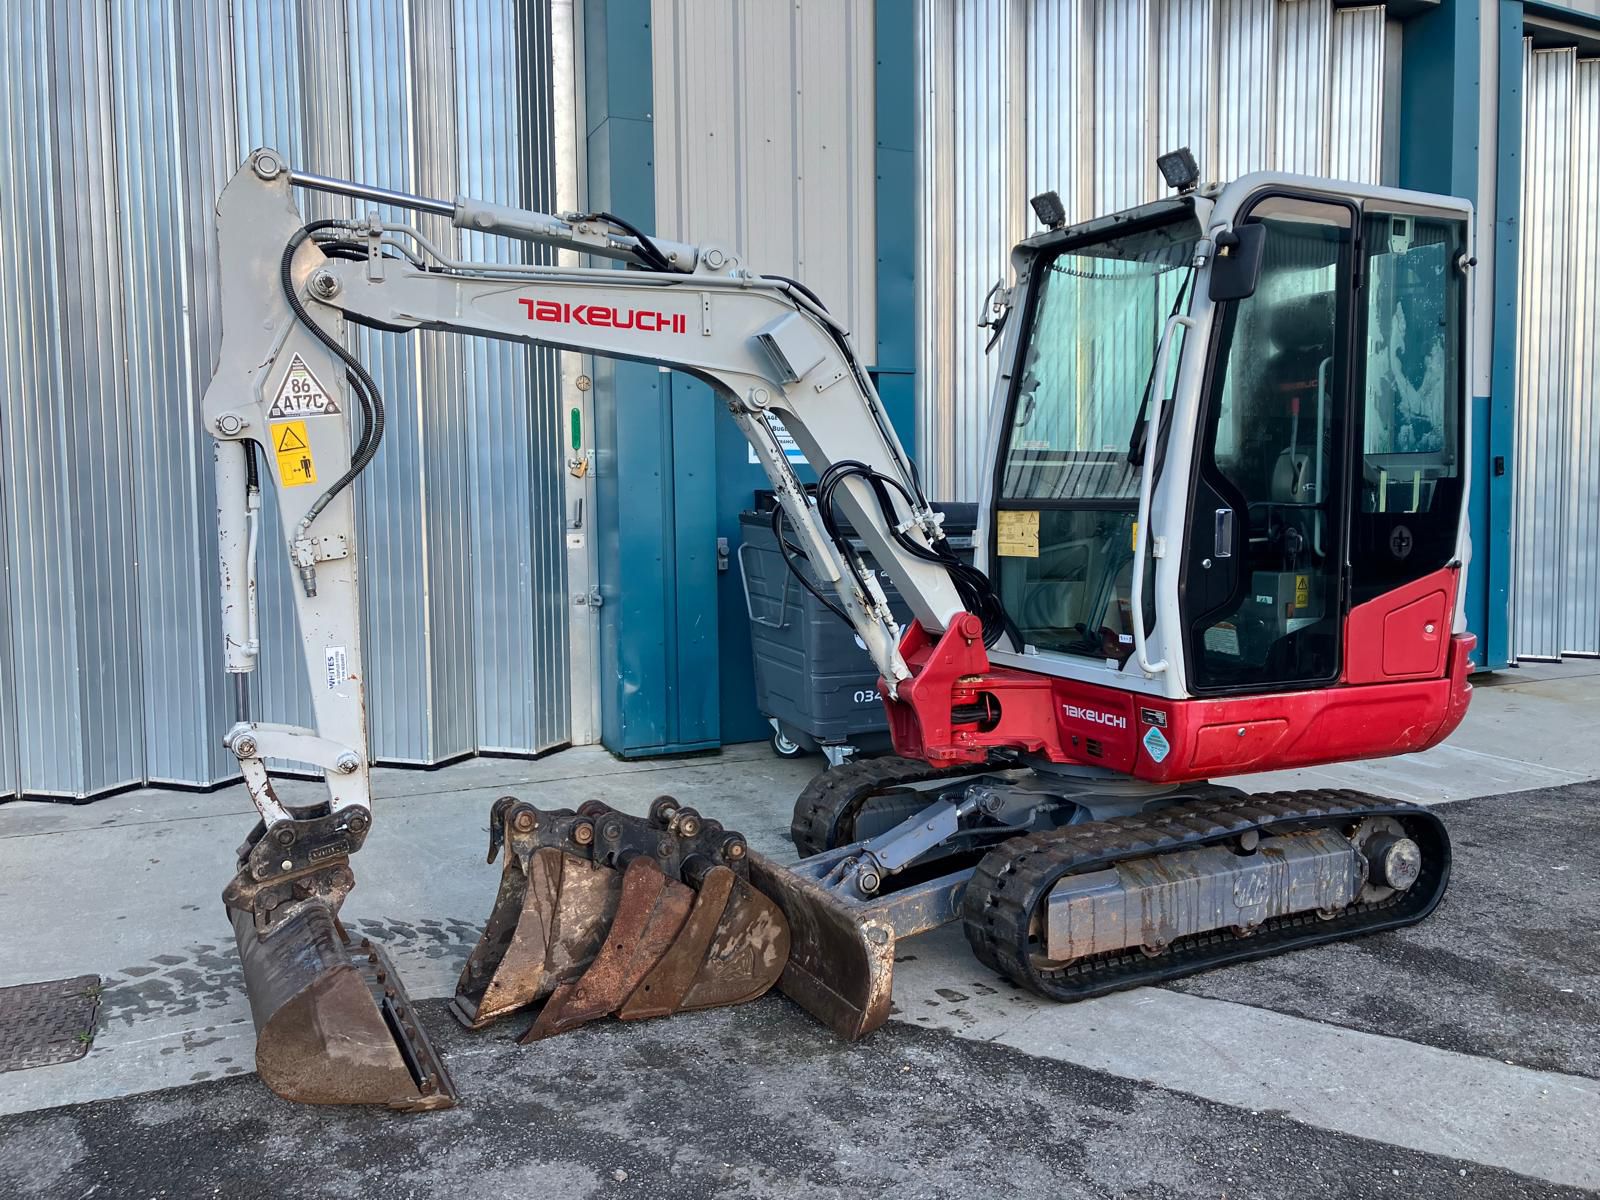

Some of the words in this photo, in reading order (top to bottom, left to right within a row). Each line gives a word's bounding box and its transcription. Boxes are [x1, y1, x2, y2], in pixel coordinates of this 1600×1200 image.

[518, 298, 686, 334] TAKEUCHI
[291, 378, 311, 394] 86
[283, 394, 324, 411] AT7C
[327, 656, 335, 690] WHITES
[1062, 704, 1126, 729] TAKEUCHI
